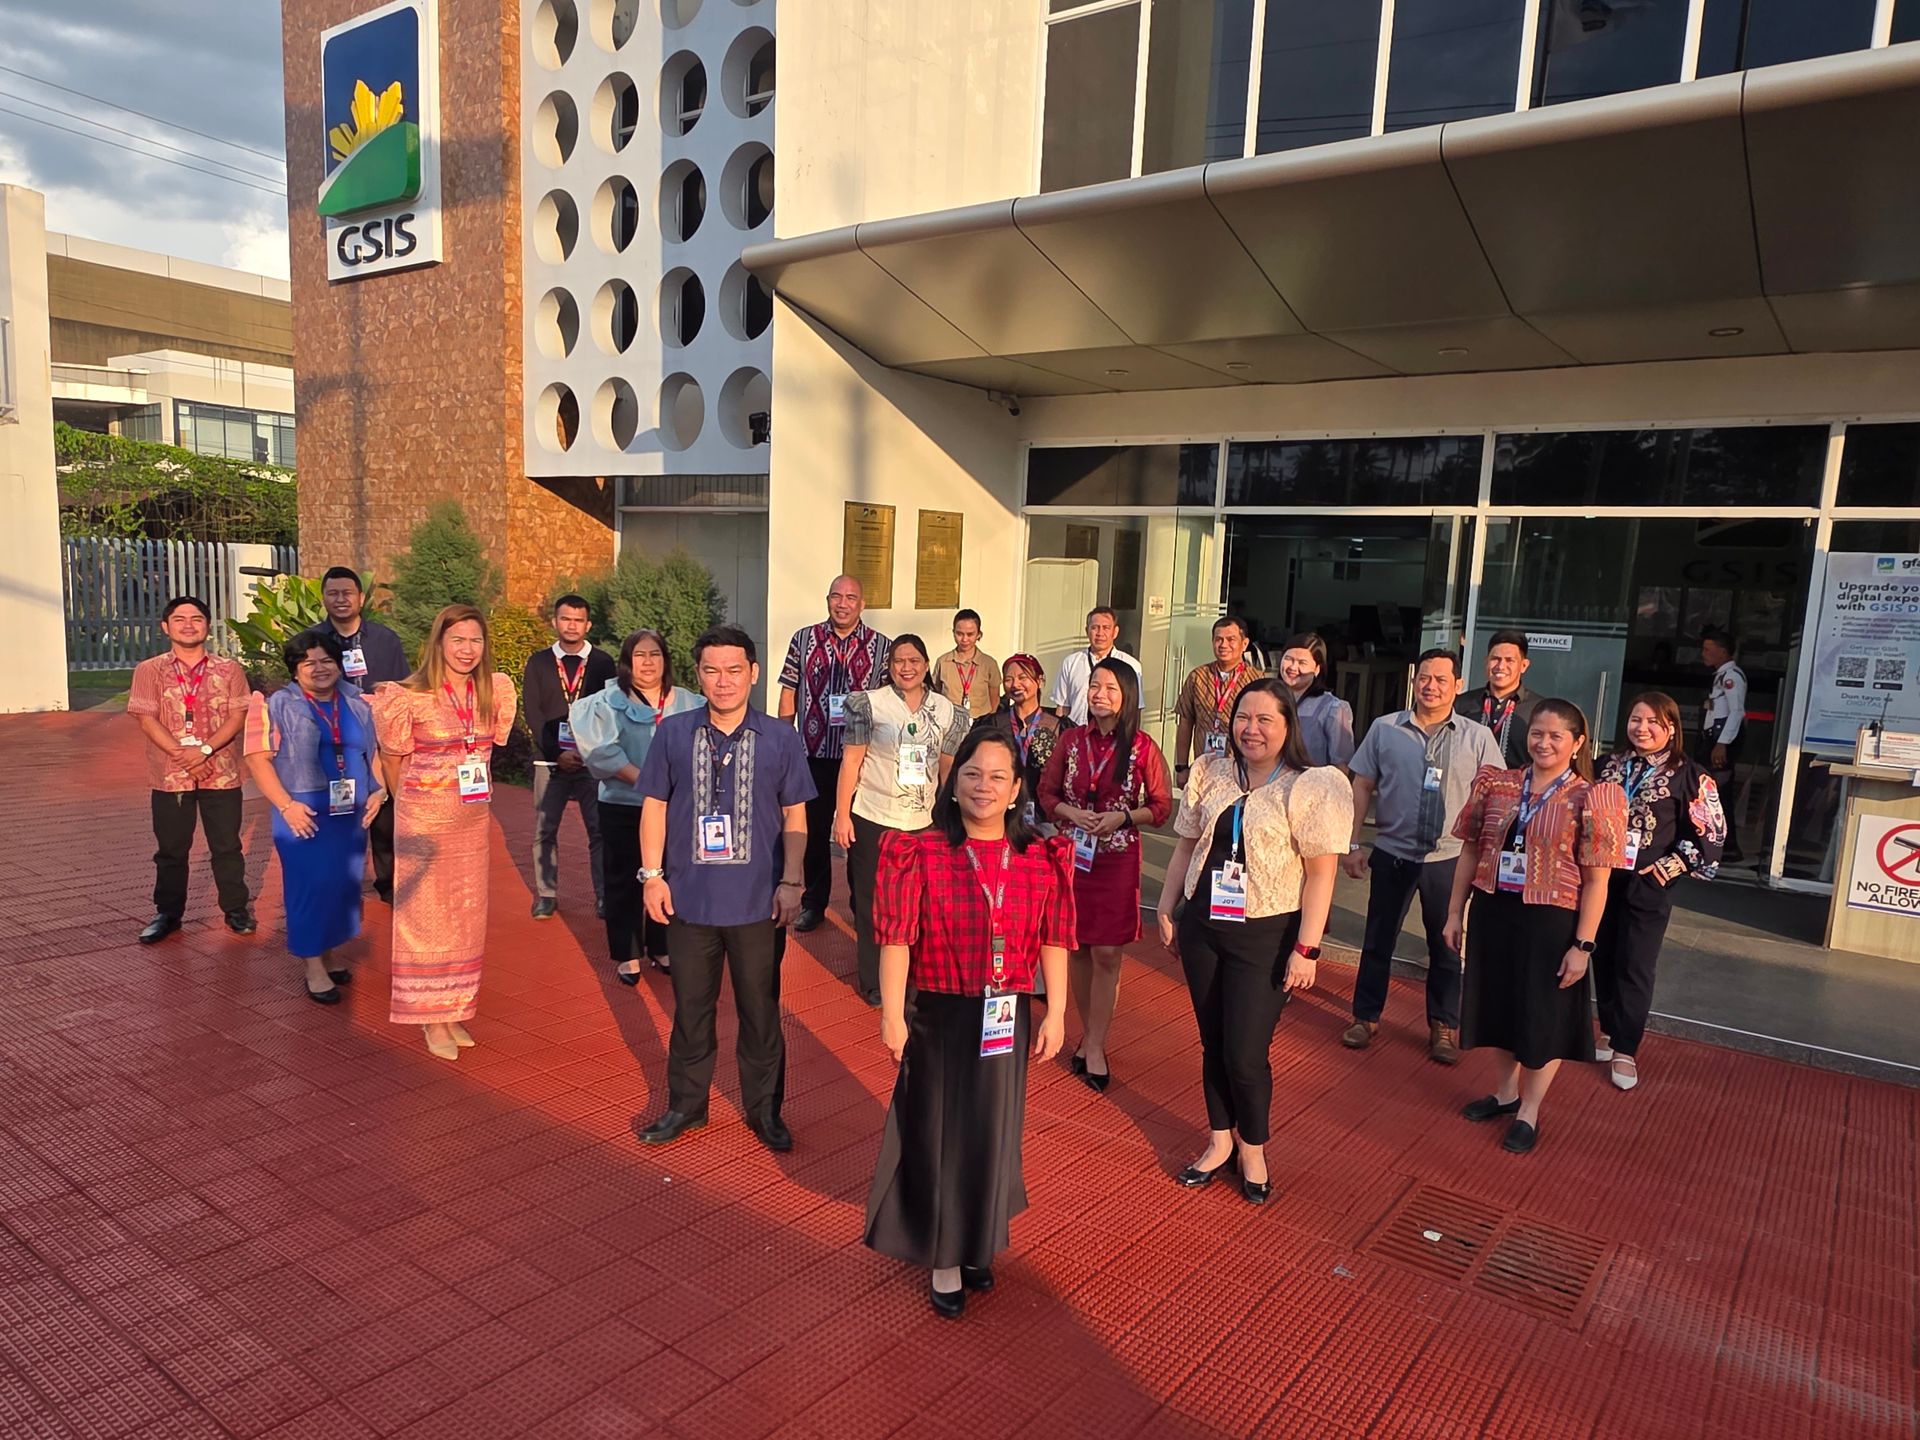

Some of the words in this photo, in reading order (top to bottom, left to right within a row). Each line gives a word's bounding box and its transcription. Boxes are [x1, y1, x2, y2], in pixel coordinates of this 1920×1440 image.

[337, 213, 417, 267] GSIS
[1839, 582, 1899, 592] Upgrade
[1837, 592, 1881, 603] digital
[1836, 602, 1866, 611] with
[1870, 603, 1903, 612] GSIS
[1857, 881, 1881, 893] NO
[1885, 885, 1920, 899] FIRE
